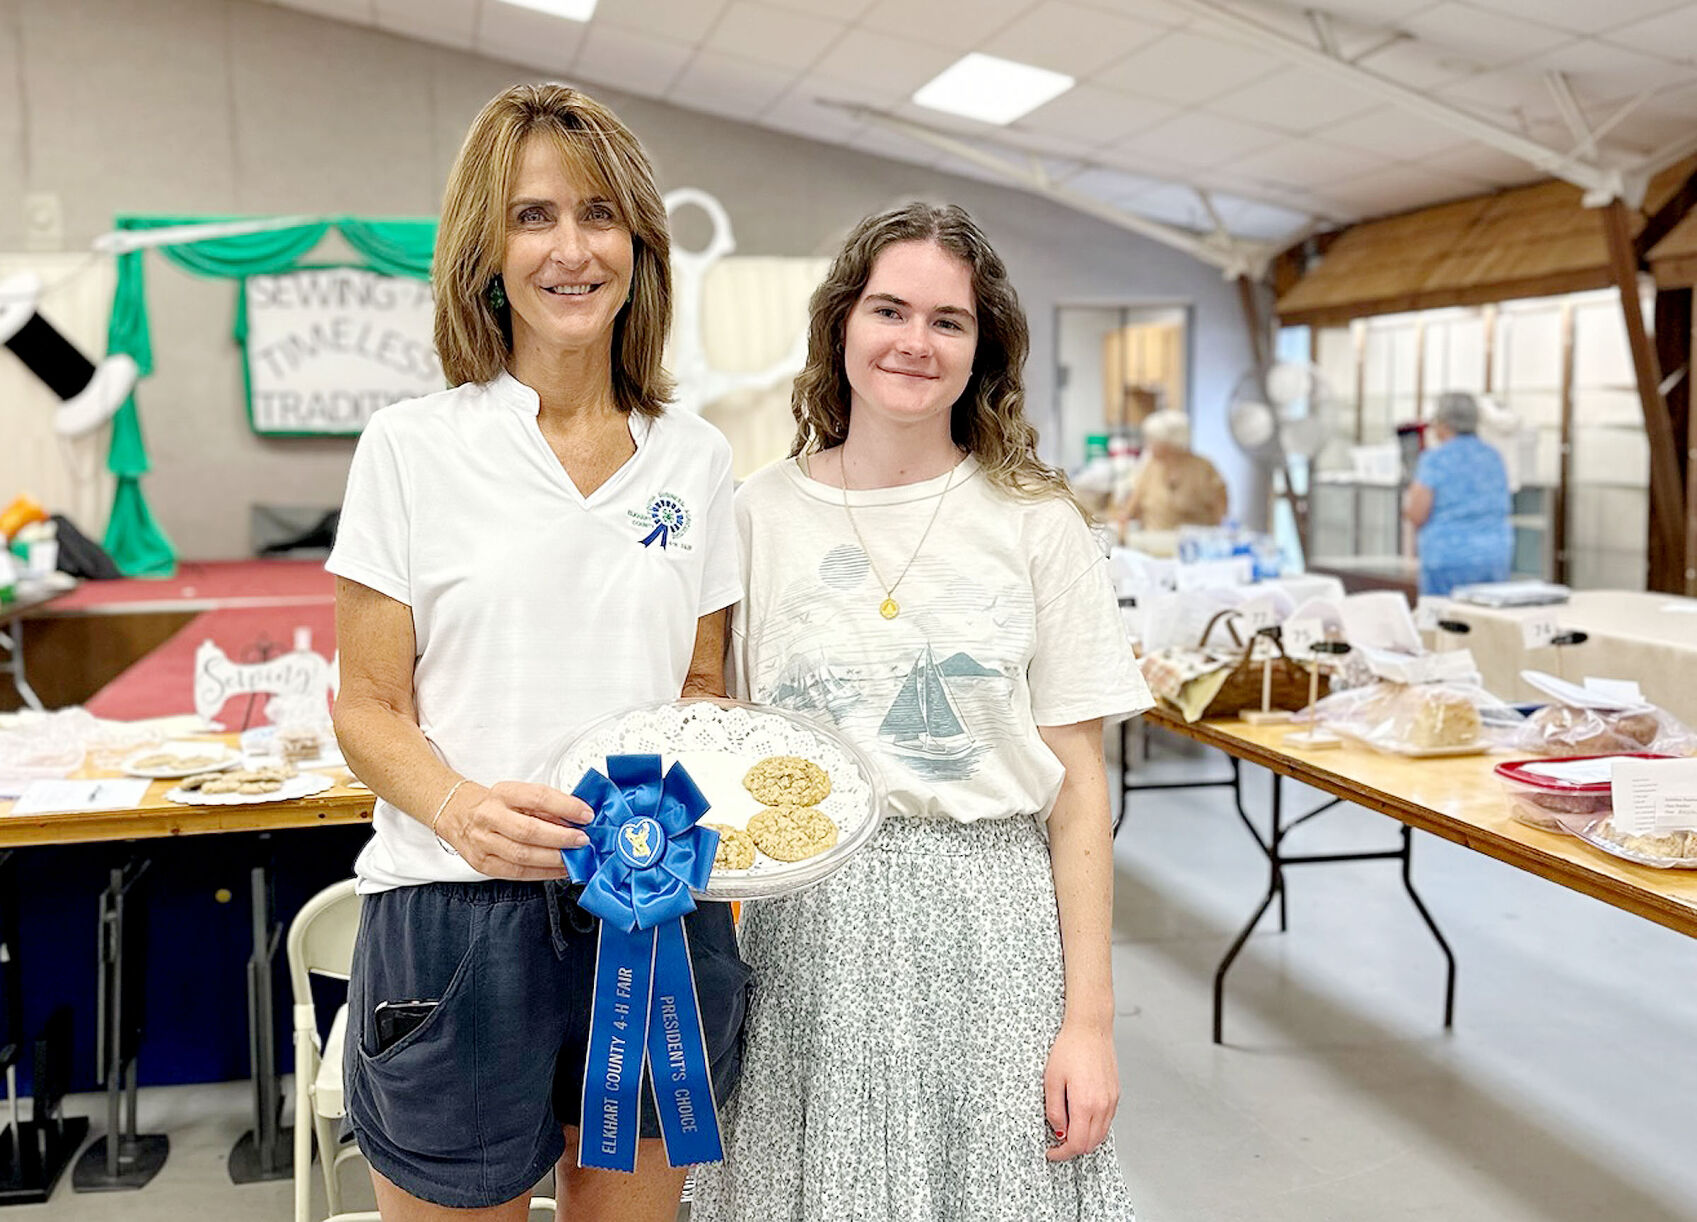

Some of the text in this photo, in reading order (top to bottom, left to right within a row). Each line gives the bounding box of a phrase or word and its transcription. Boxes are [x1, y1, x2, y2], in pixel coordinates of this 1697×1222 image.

[254, 276, 396, 310] SEWING
[256, 316, 440, 382] TIMELESS
[601, 966, 633, 1155] ELKHART COUNTY 4-H FAIR
[660, 995, 699, 1134] PRESIDENT'S CHOICE
